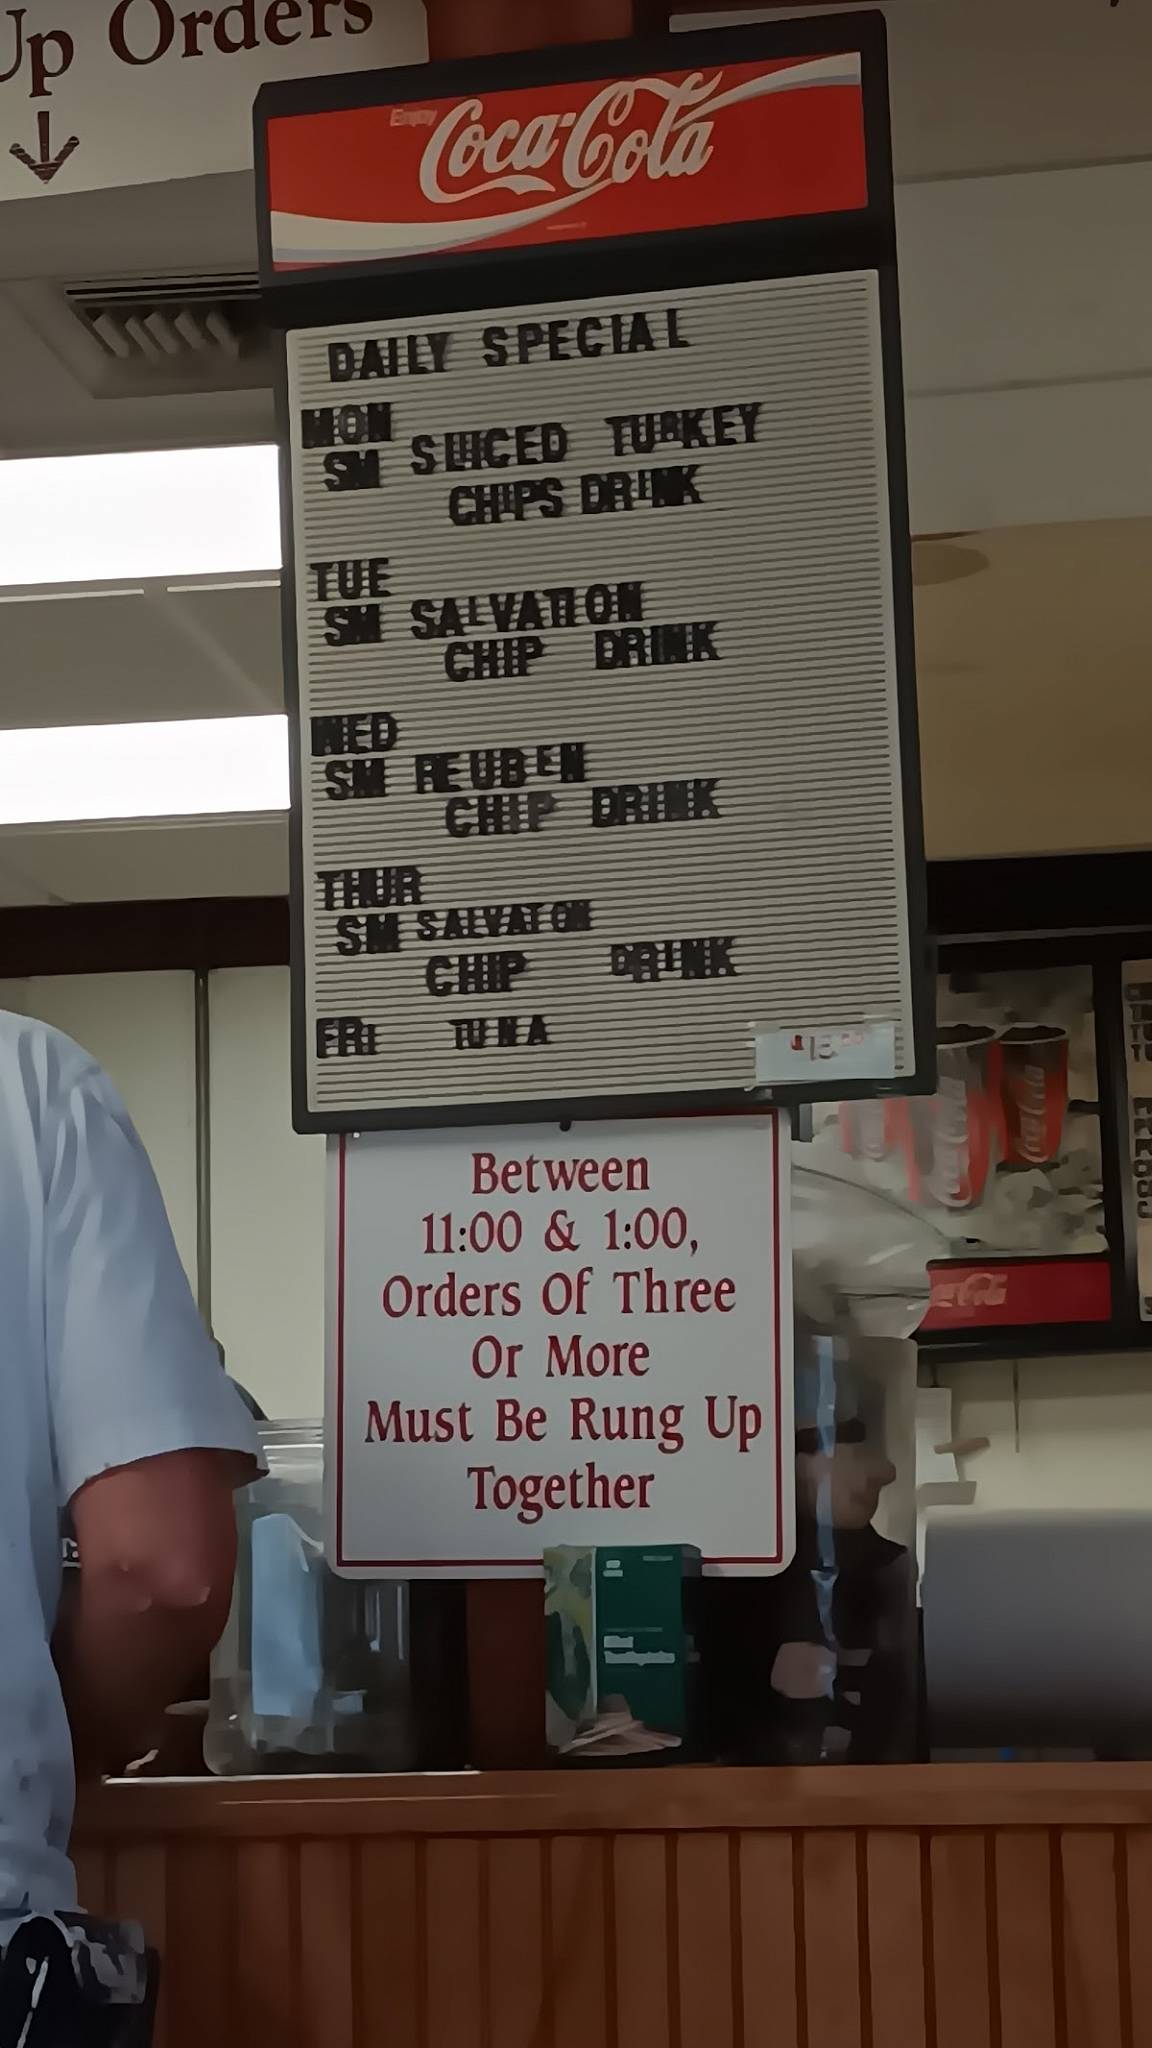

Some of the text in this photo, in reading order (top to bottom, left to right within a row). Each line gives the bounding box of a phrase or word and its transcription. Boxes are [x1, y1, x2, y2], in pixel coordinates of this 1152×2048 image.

[108, 0, 374, 66] Orders
[419, 71, 722, 203] Coca-Cola
[328, 308, 691, 382] DAILY SPECIAL
[301, 402, 393, 449] MON
[323, 449, 381, 491] SM
[605, 402, 763, 456] TURKEY
[448, 464, 704, 526] CHIPS DRINK
[310, 557, 392, 601] TUE
[324, 580, 645, 646] SM SALVATION
[443, 621, 722, 682] CHIP DRINK
[311, 711, 399, 756] WED
[324, 741, 586, 799] SM REUBEN
[445, 778, 722, 837] CHIP DRINK
[317, 866, 423, 911] THUR
[336, 912, 401, 955] SM
[425, 935, 739, 996] CHIP DRINK
[316, 1015, 550, 1059] FRI TUNA
[471, 1152, 650, 1195] Between
[422, 1206, 699, 1257] 11:00 & 1:00,
[382, 1266, 737, 1318] Orders Of Three
[472, 1335, 651, 1379] Or More
[364, 1395, 762, 1455] Must Be Rung Up
[467, 1462, 655, 1525] Together
